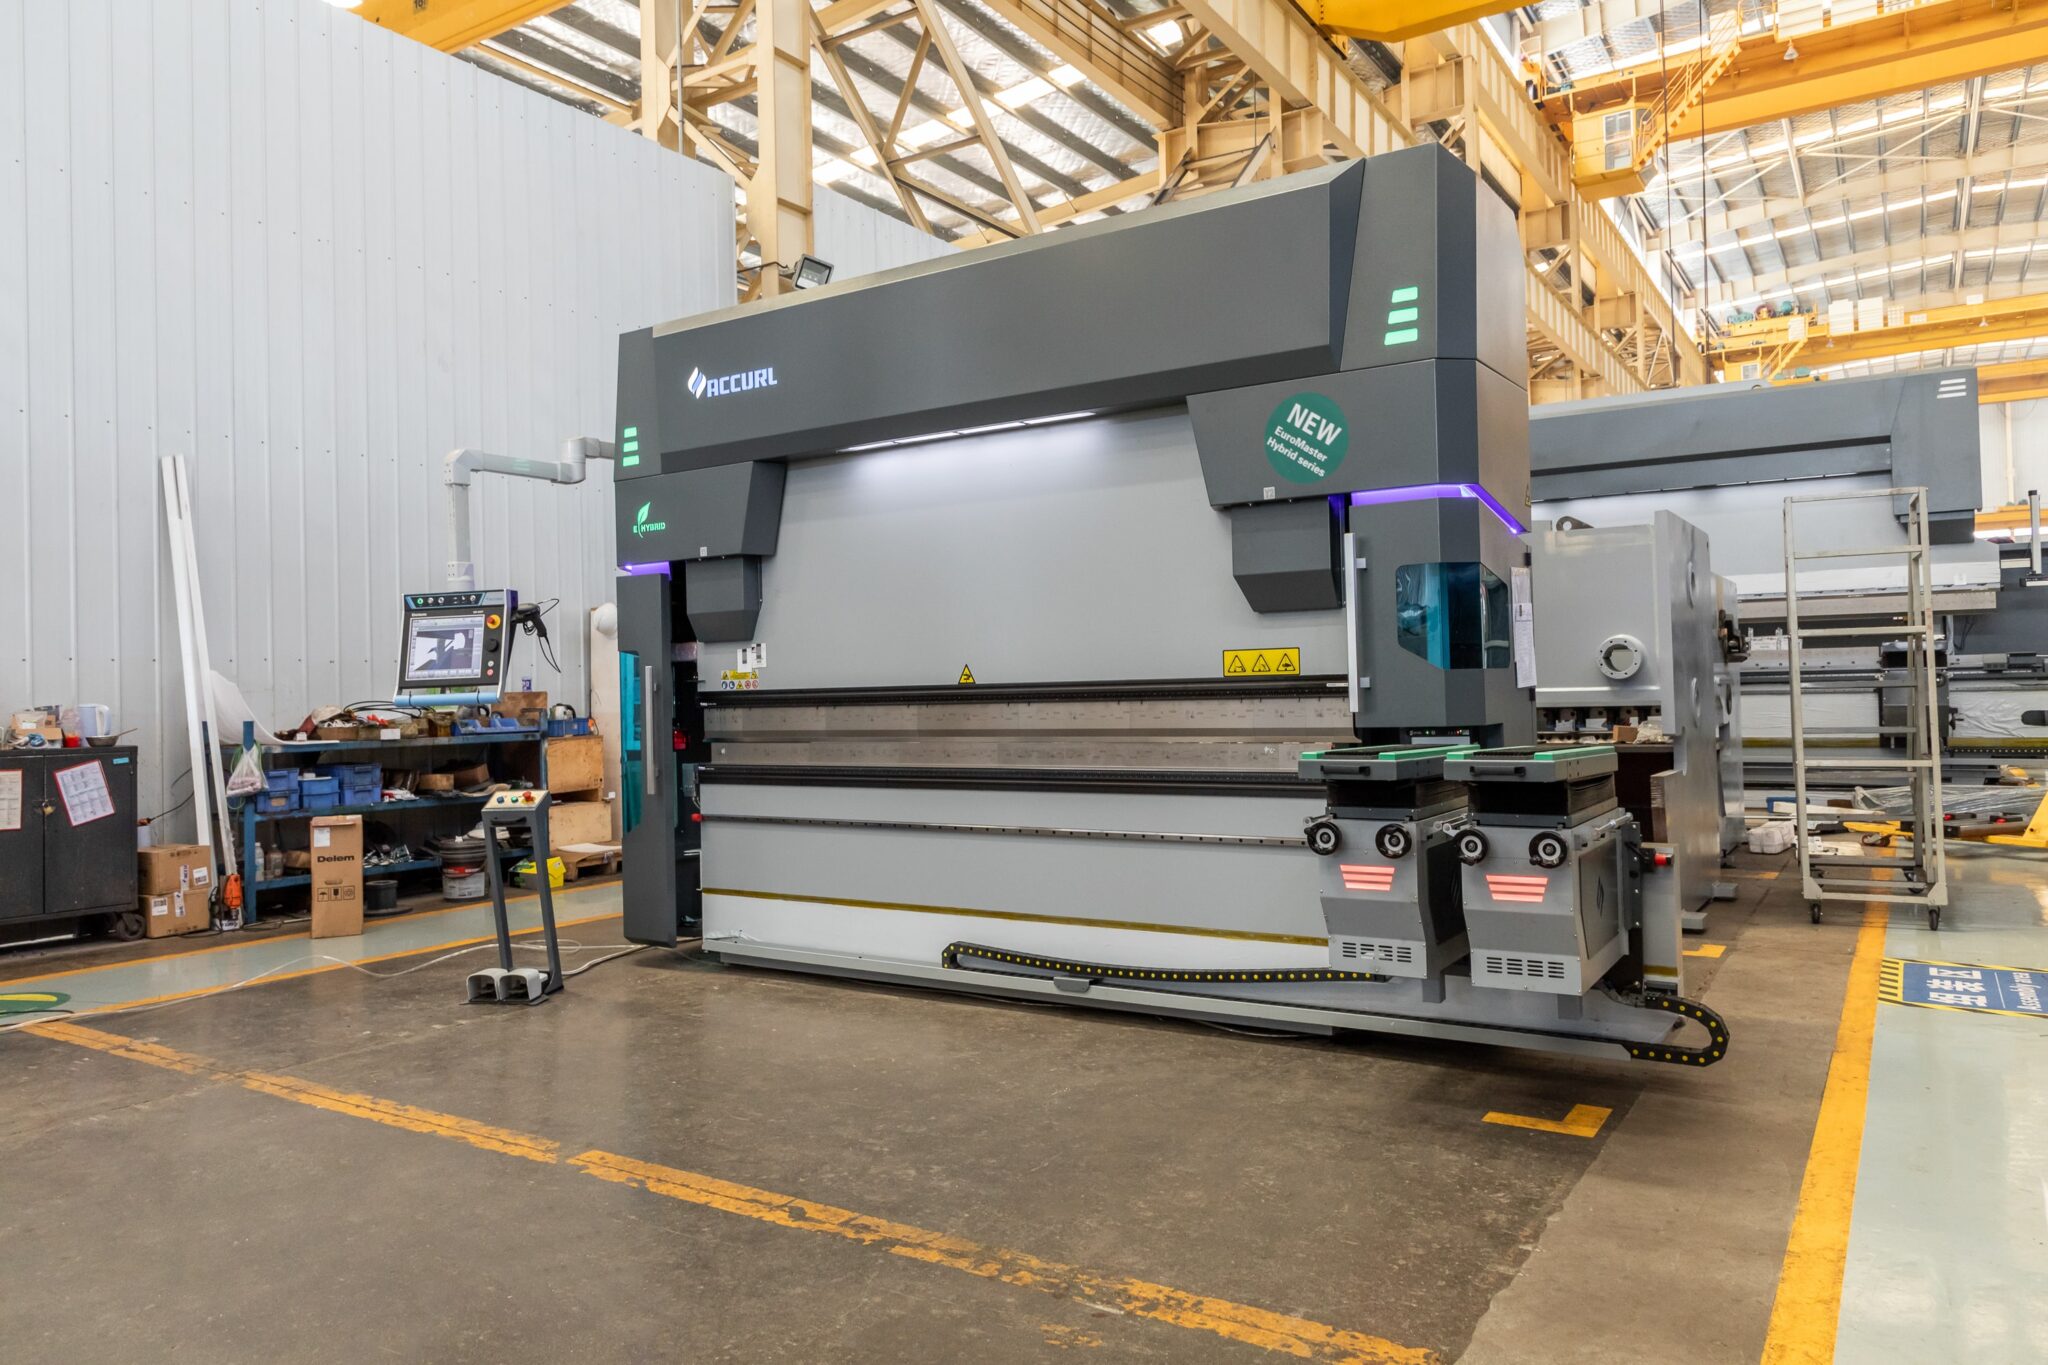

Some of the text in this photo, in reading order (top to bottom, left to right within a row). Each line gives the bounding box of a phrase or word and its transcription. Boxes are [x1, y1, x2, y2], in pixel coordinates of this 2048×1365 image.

[707, 367, 778, 398] ACCURL
[1274, 426, 1328, 462] EuroMaster
[1287, 403, 1342, 446] NEW
[1266, 437, 1326, 477] Hybrid series
[317, 855, 355, 863] Delem
[1926, 967, 1987, 1007] 组装区
[2009, 972, 2043, 1011] Assembly area
